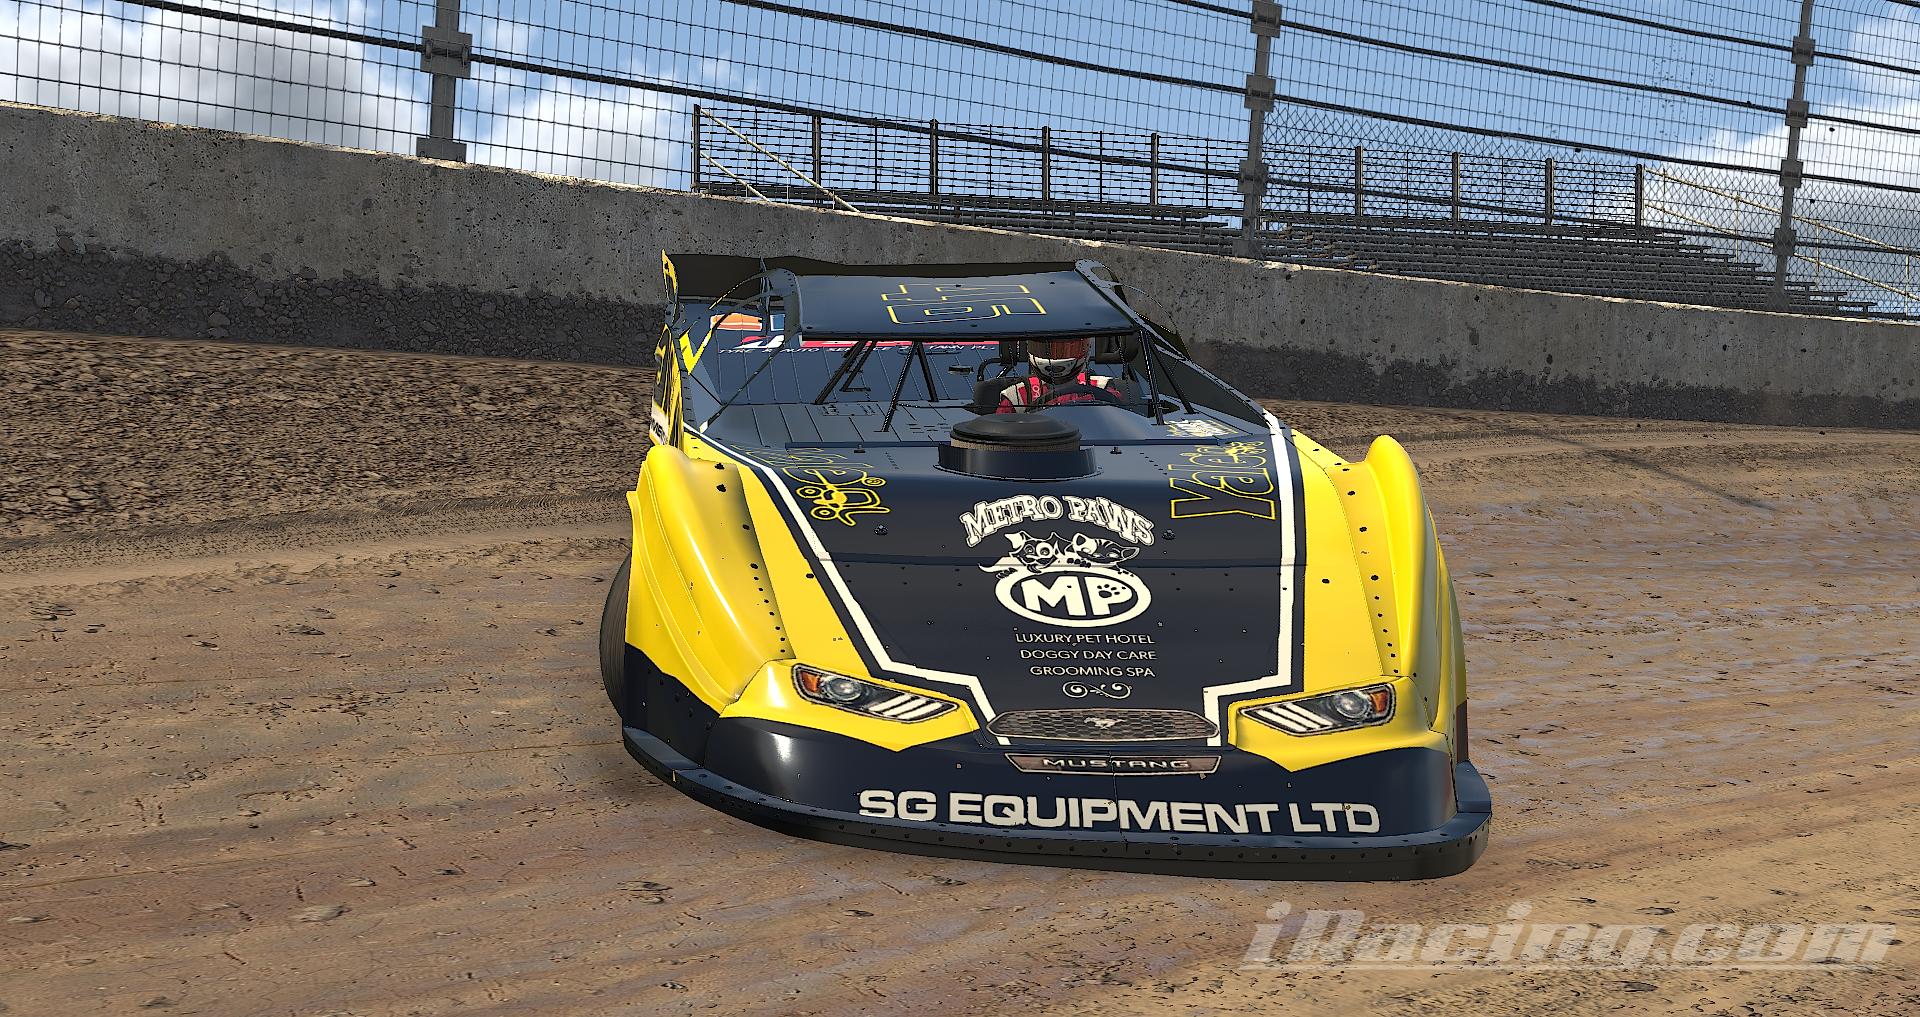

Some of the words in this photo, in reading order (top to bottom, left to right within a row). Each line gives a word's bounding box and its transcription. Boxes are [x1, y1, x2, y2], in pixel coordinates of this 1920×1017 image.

[960, 494, 1064, 547] METRO
[1062, 495, 1155, 546] PAWS
[1021, 575, 1133, 616] MP
[1015, 633, 1073, 643] LUXURY
[1076, 634, 1102, 644] PET
[1105, 634, 1155, 645] HOTEL
[1020, 649, 1080, 660] DOGGY
[1083, 650, 1114, 660] DAY
[1116, 650, 1158, 660] CARE
[1029, 666, 1123, 677] GROOMING
[1126, 667, 1156, 678] SPA
[1042, 758, 1191, 769] MUSTANG
[858, 789, 938, 822] SG
[949, 792, 1280, 834] EQUIPMENT
[1288, 802, 1381, 834] LTD
